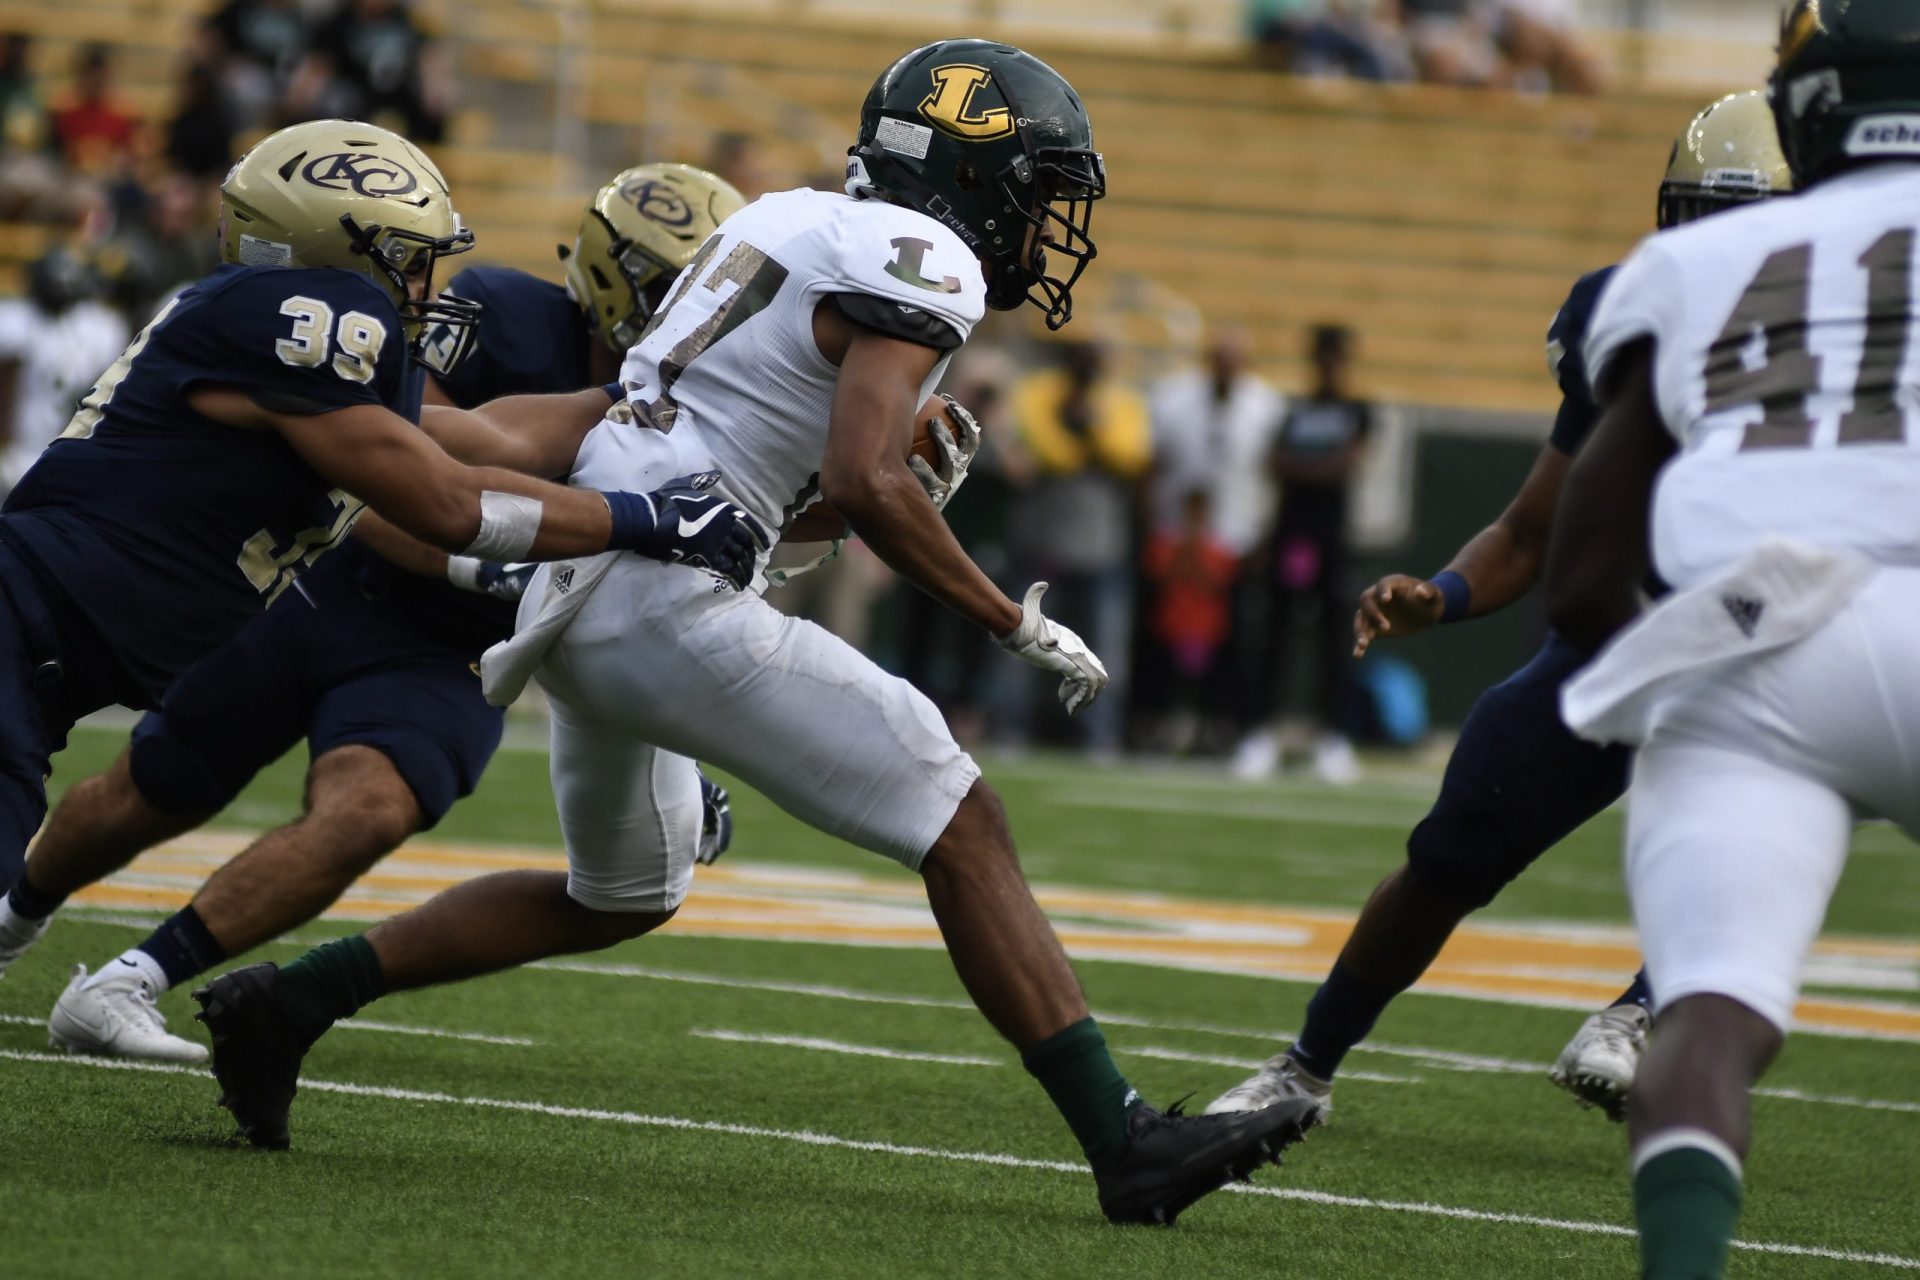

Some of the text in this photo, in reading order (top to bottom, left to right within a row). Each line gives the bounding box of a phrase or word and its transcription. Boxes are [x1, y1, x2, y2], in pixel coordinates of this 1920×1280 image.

[917, 63, 1015, 142] L
[312, 153, 403, 198] KC
[883, 236, 962, 294] L
[275, 295, 387, 385] 39
[1703, 227, 1915, 452] 41
